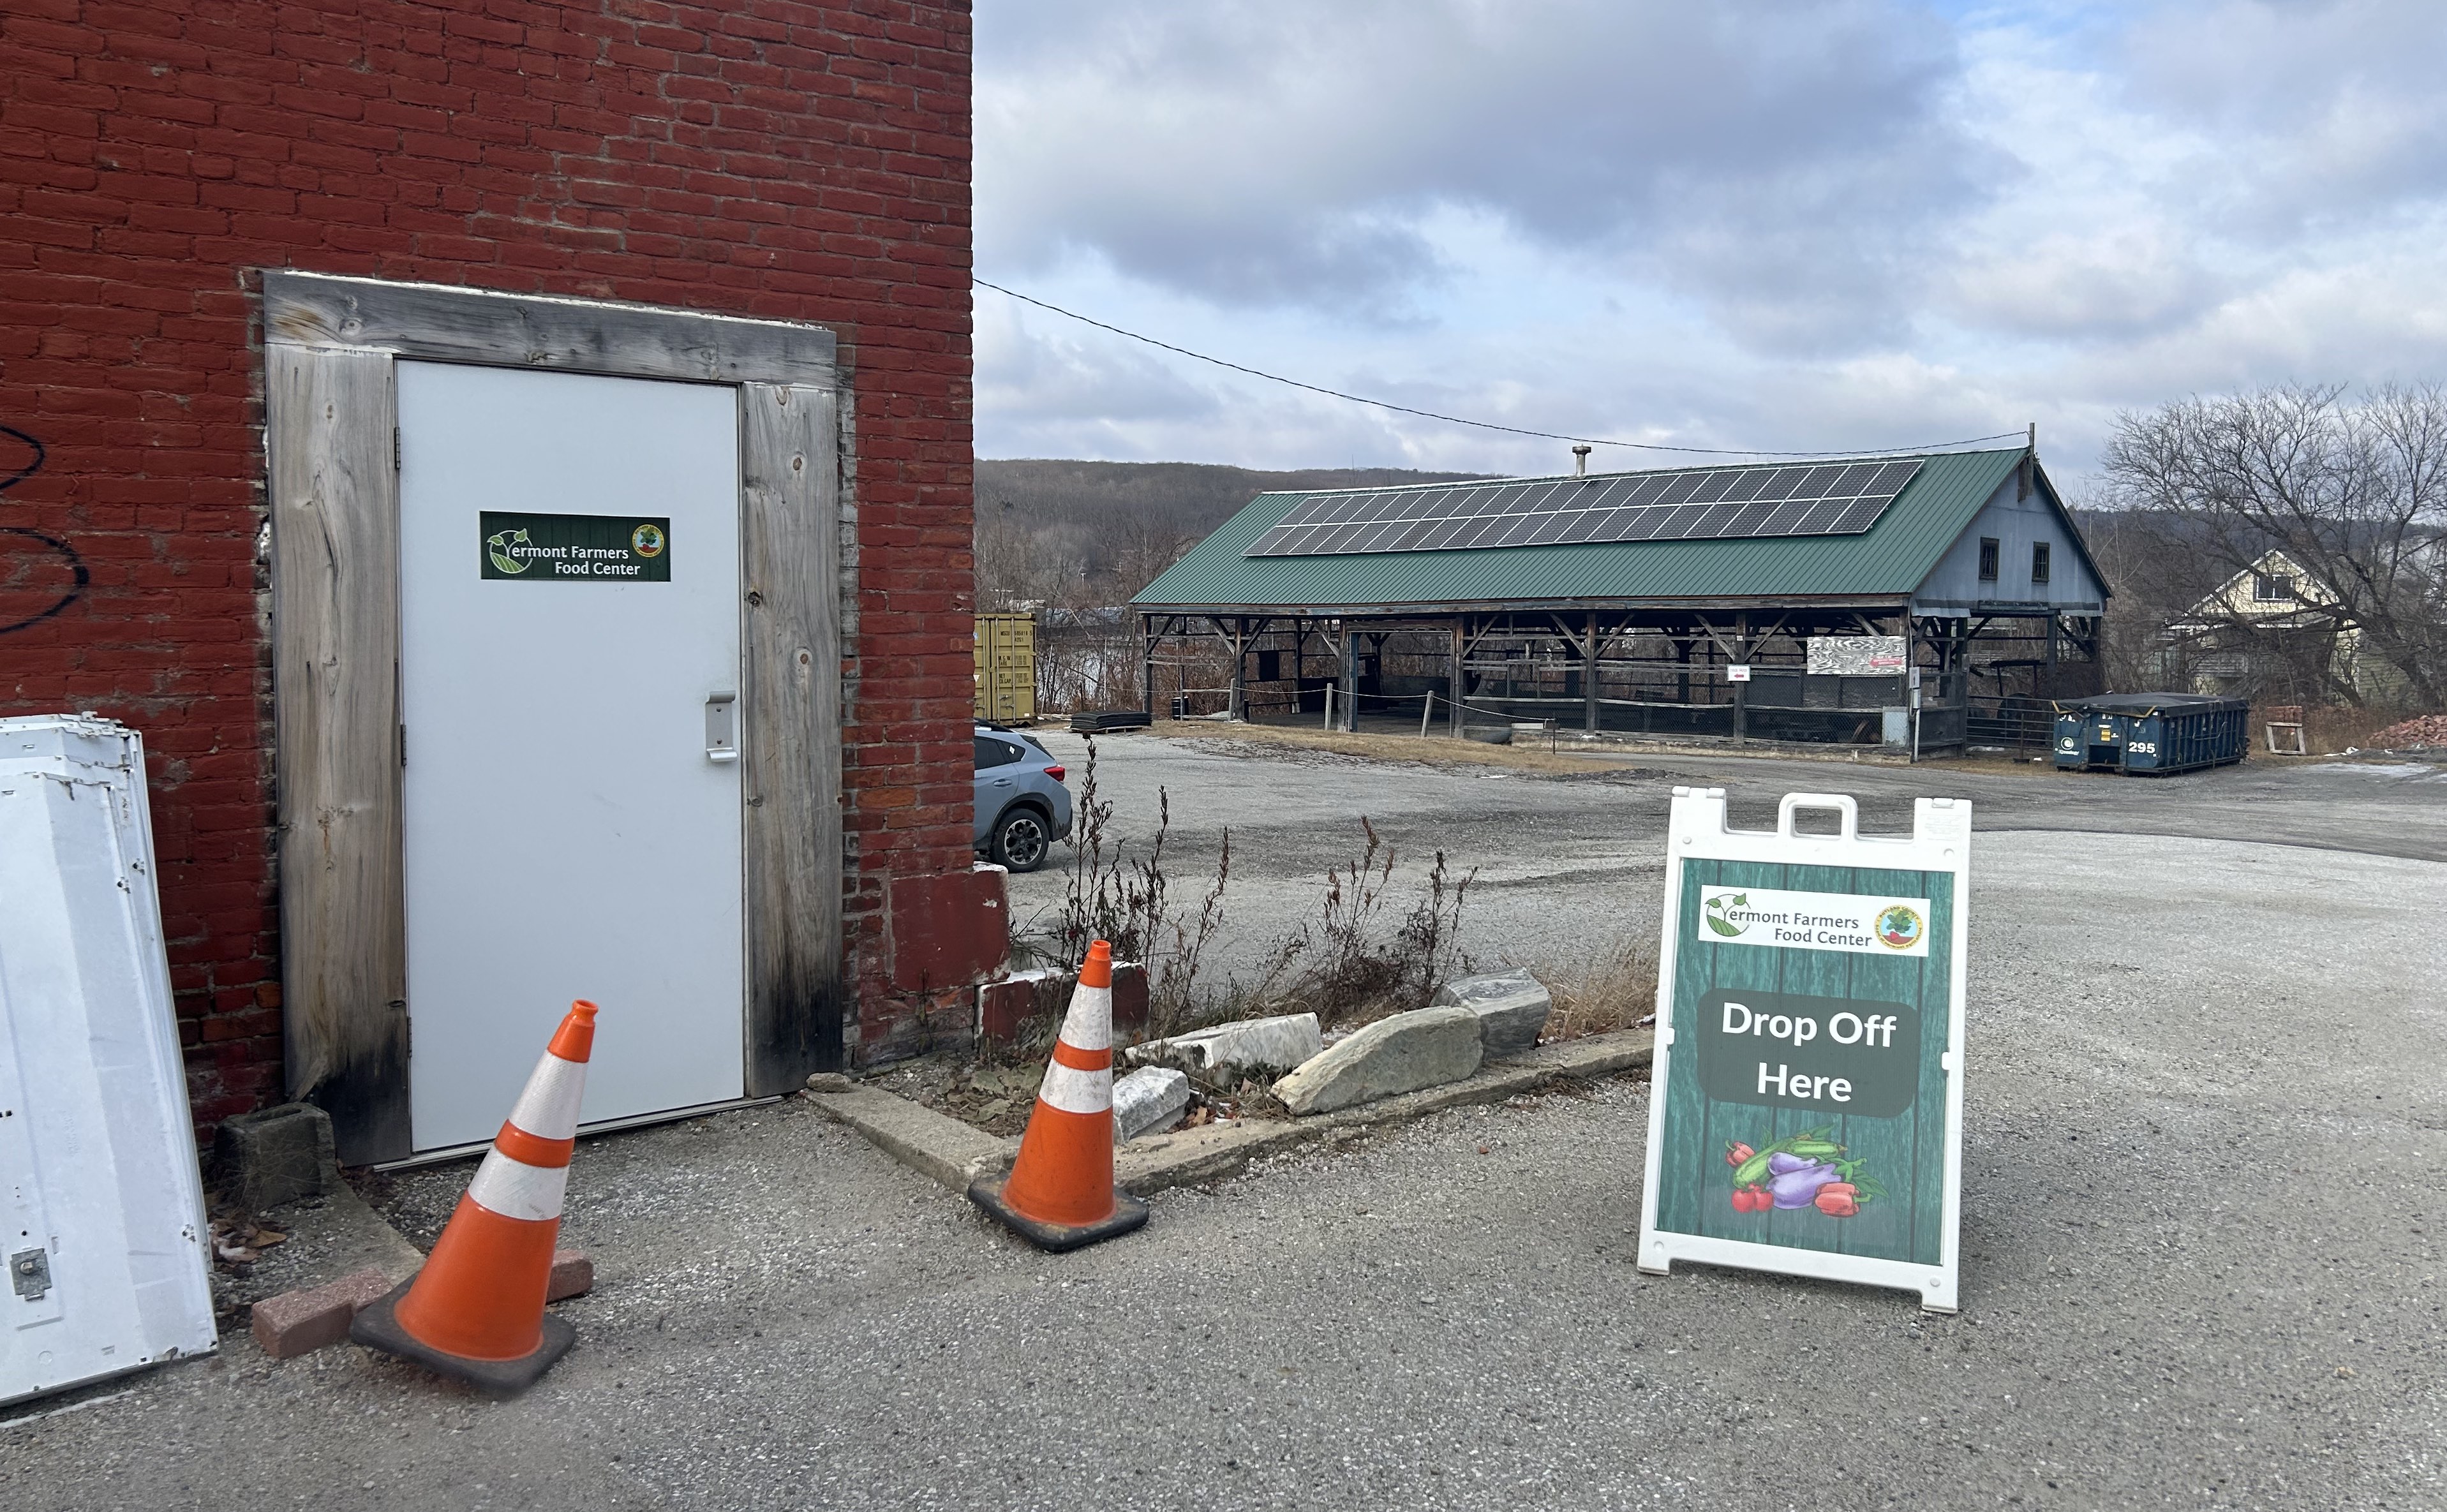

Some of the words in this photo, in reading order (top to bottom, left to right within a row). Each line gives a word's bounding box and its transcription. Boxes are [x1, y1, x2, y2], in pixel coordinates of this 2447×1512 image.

[572, 546, 629, 559] Farmers
[555, 561, 589, 574] Food
[593, 562, 641, 575] Center
[2128, 742, 2155, 753] 295
[1794, 913, 1859, 929] Farmers
[1774, 929, 1812, 943] Food
[1817, 932, 1872, 947] Center
[1722, 1002, 1818, 1046] Drop
[1829, 1012, 1898, 1048] Off
[1757, 1062, 1852, 1102] Here
